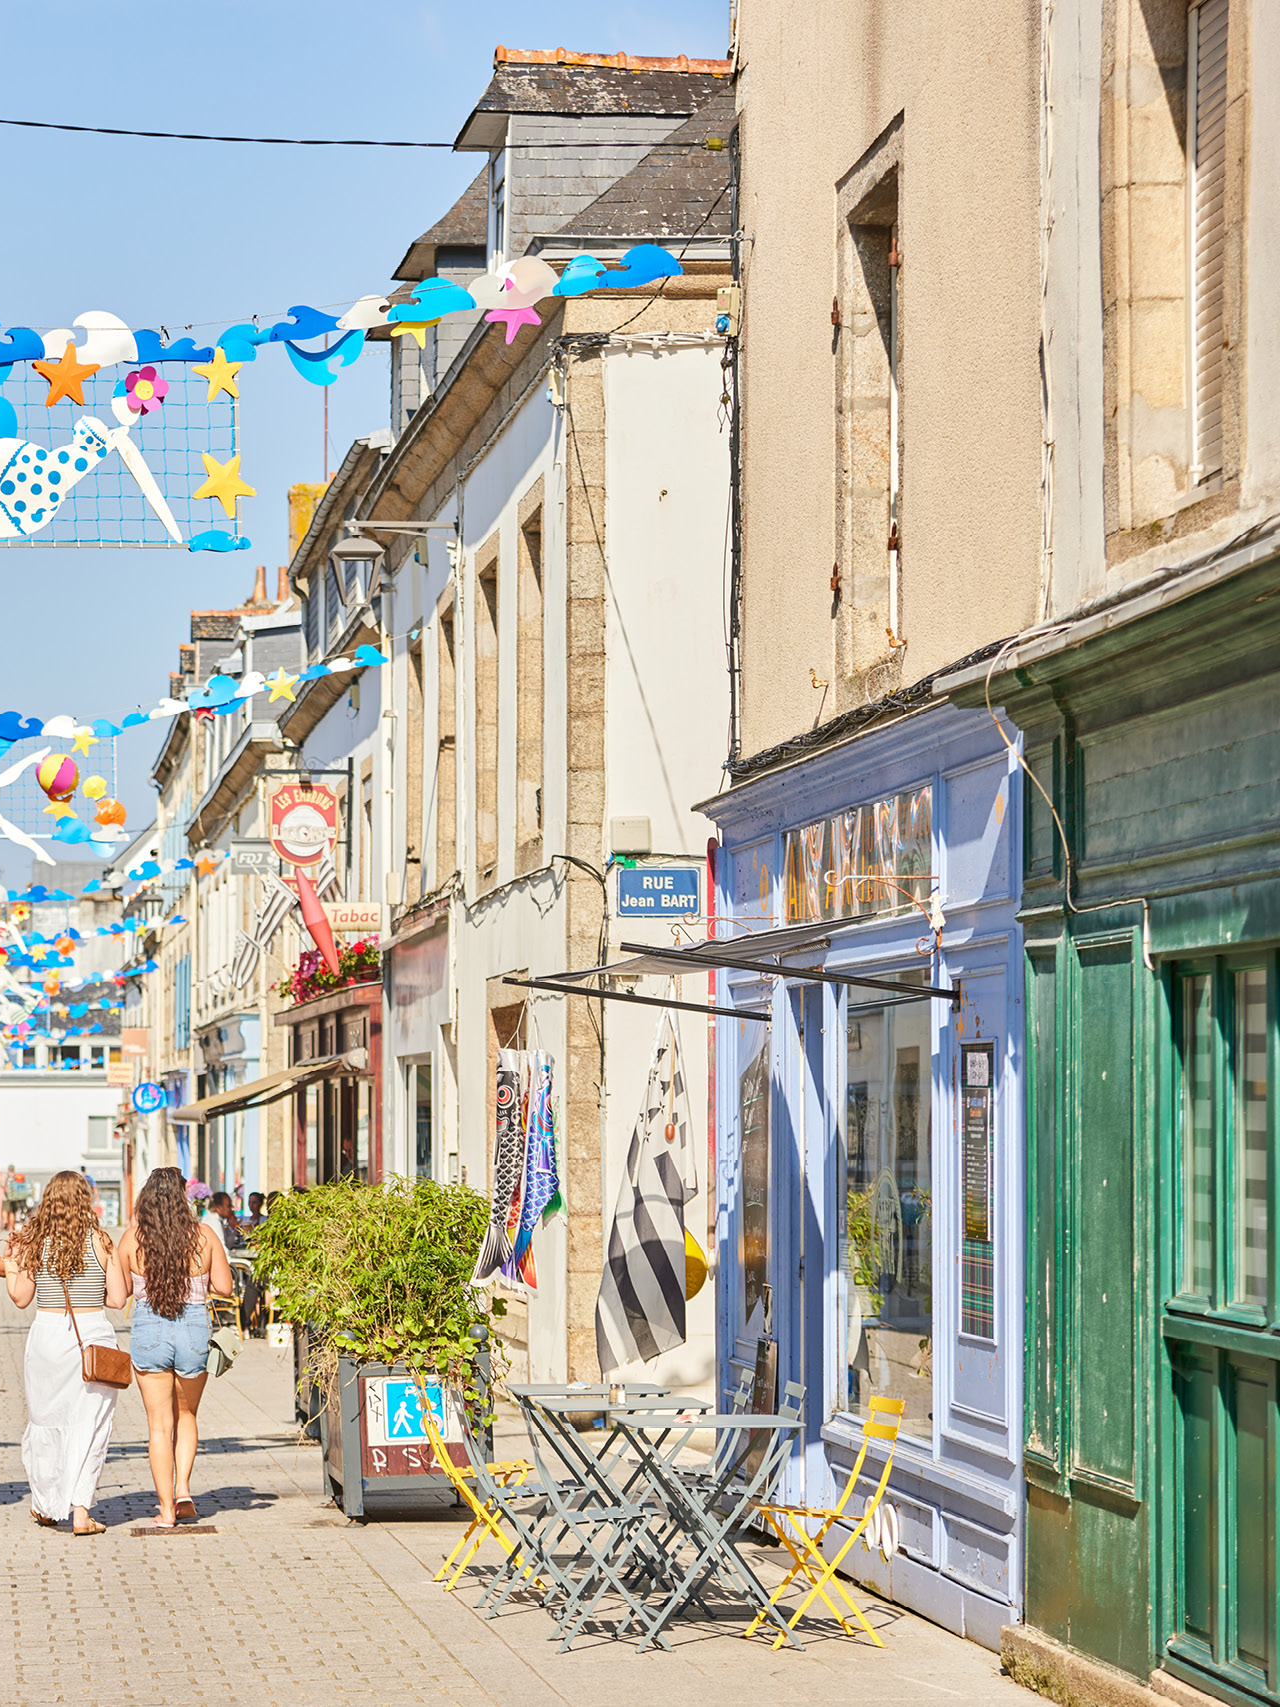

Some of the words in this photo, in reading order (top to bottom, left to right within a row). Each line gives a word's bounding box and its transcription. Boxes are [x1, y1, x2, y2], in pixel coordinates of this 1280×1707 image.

[274, 792, 292, 810] LES
[293, 789, 334, 810] EMBRUNS
[239, 853, 263, 864] FDJ
[642, 876, 674, 890] RUE
[621, 894, 655, 908] Jean
[661, 894, 697, 908] BART
[331, 909, 379, 923] Tabac
